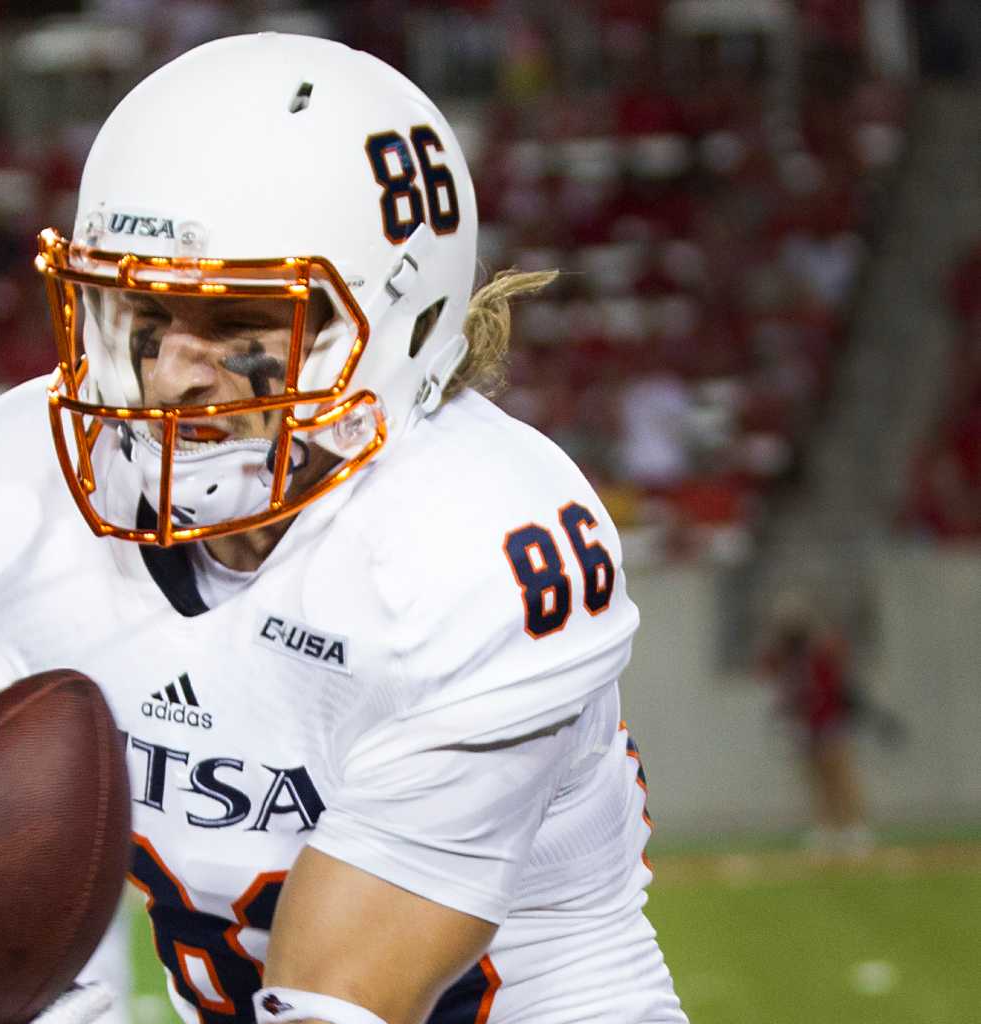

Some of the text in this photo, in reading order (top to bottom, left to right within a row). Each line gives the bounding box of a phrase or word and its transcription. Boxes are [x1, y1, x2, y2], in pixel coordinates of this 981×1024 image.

[108, 213, 175, 239] UTSA
[364, 125, 460, 245] 86
[503, 500, 615, 640] 86
[141, 701, 213, 729] adidas
[118, 730, 326, 833] TSA
